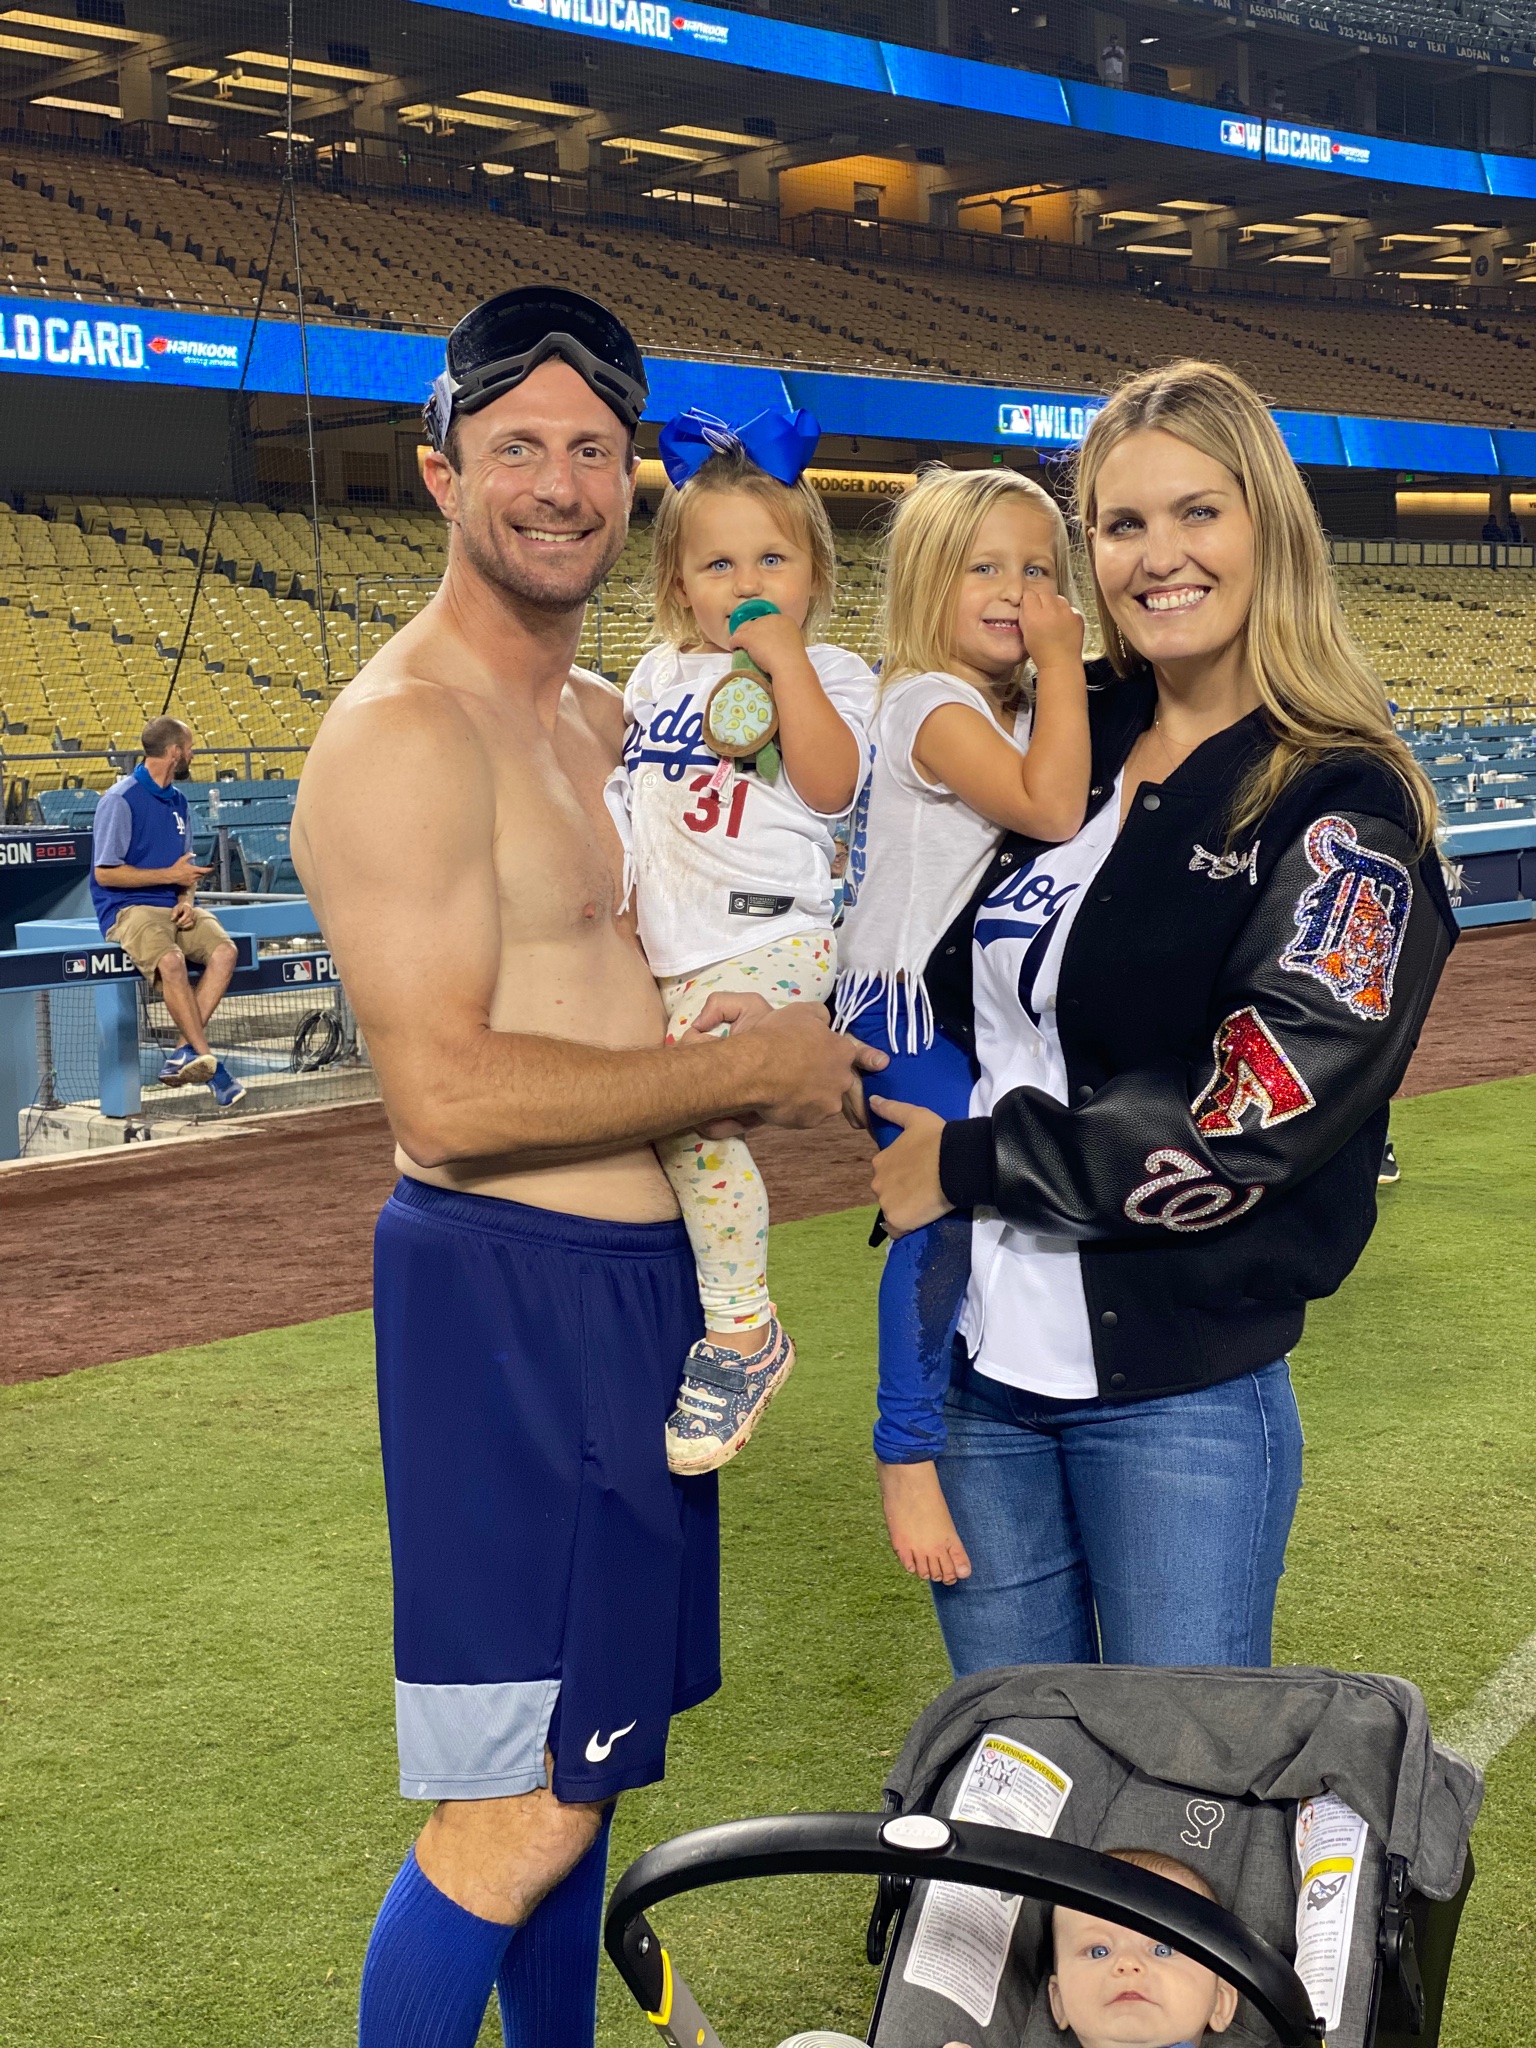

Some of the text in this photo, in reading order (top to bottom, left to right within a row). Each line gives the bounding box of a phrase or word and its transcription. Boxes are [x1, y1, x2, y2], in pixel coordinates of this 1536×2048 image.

[1250, 4, 1300, 25] ASSISTANCE
[1308, 18, 1330, 32] CALL
[1338, 24, 1399, 46] 323-224-2611
[1426, 40, 1447, 54] TEXT
[1456, 46, 1491, 61] LADFAN
[1500, 54, 1510, 64] to
[810, 476, 905, 494] DODGER DOGS
[683, 774, 750, 839] 31
[36, 845, 76, 858] 2021
[91, 953, 136, 974] MLB
